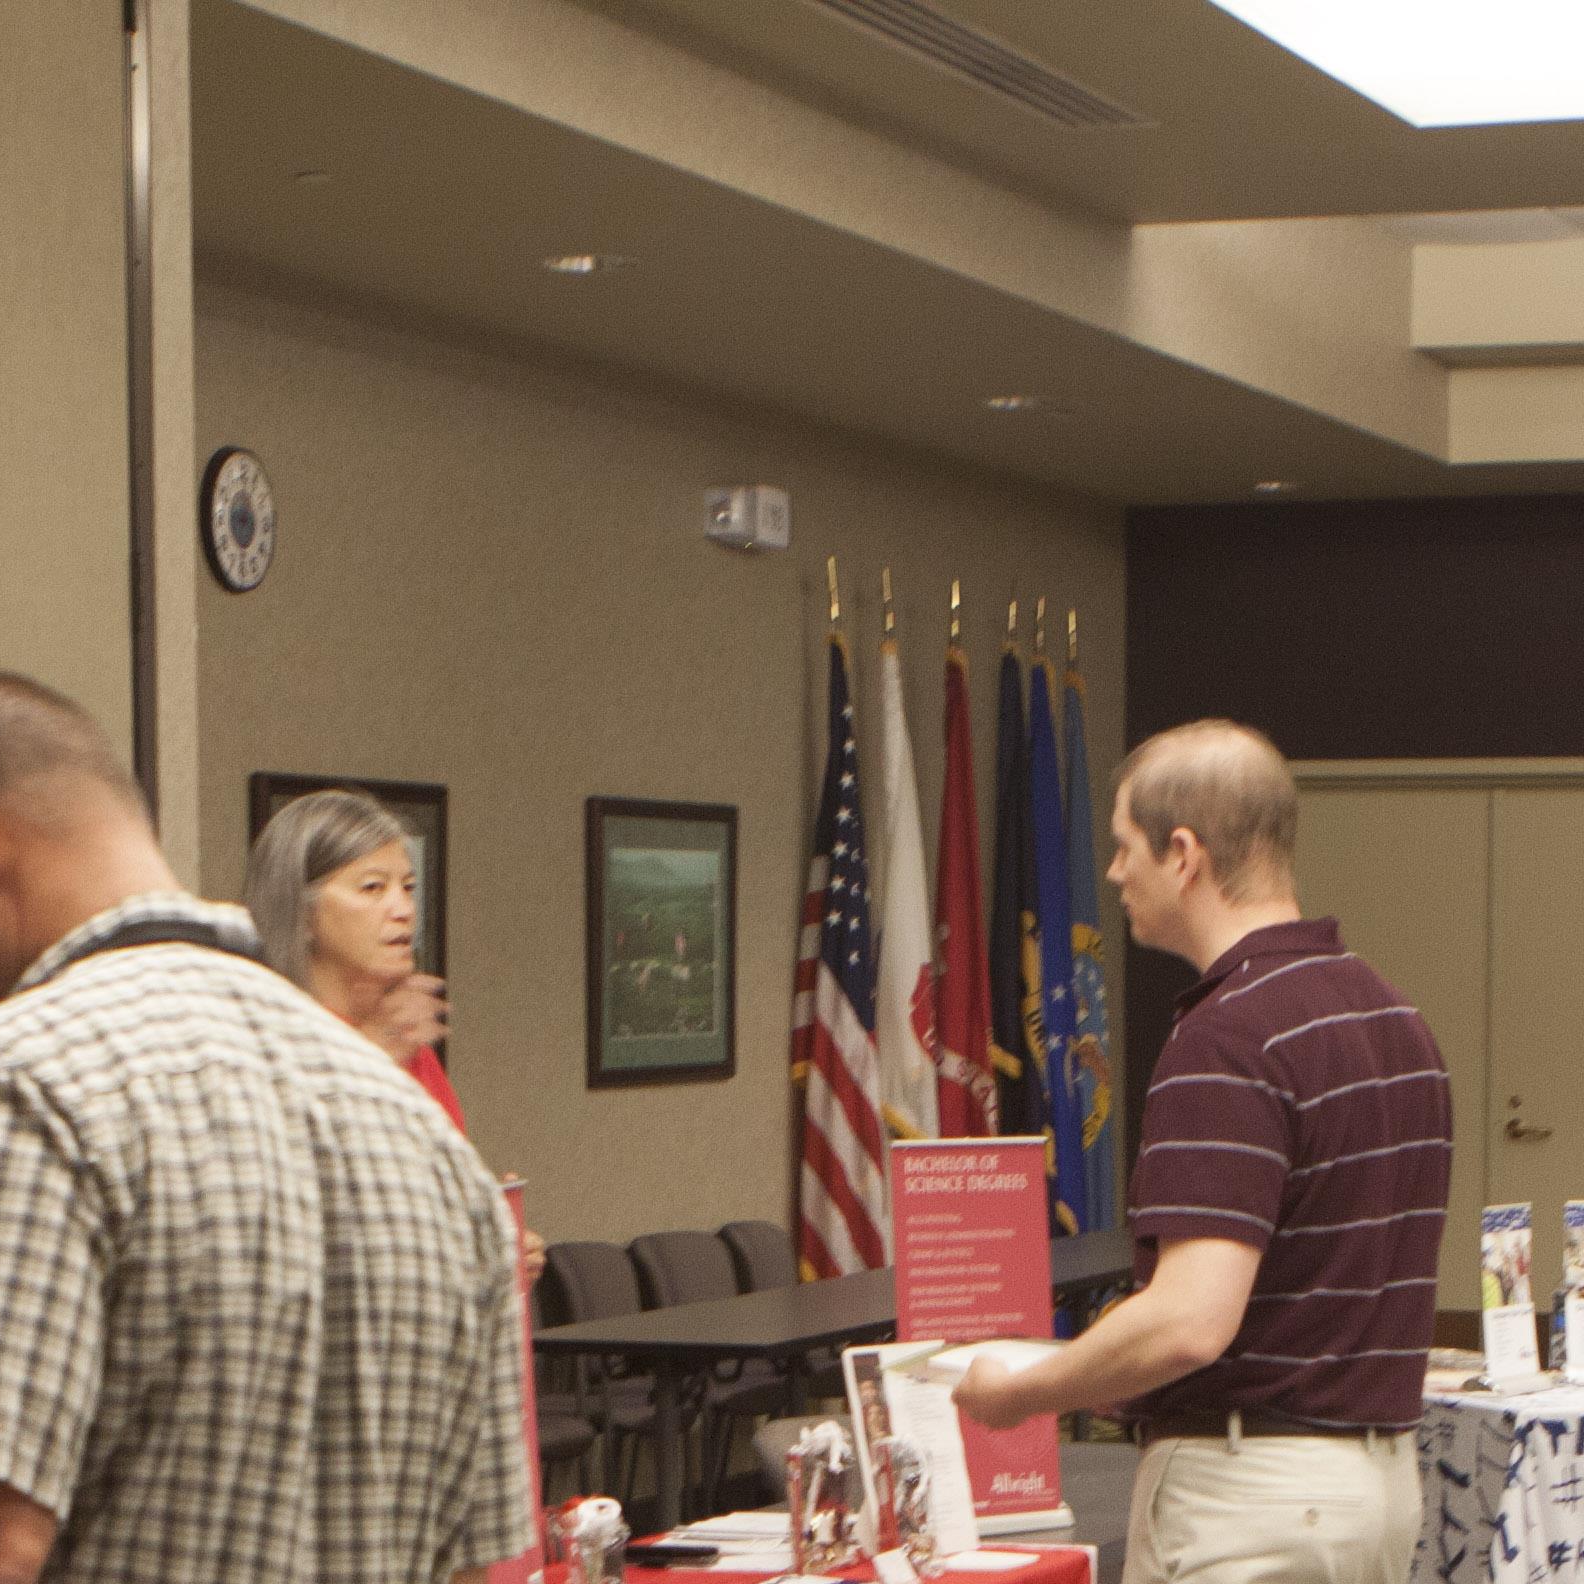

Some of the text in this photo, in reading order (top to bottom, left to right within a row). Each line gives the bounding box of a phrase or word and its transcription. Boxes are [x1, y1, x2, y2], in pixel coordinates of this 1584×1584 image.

[904, 1153, 1000, 1174] BACHELOR OF
[905, 1173, 1029, 1194] SCIENCE DEGREES
